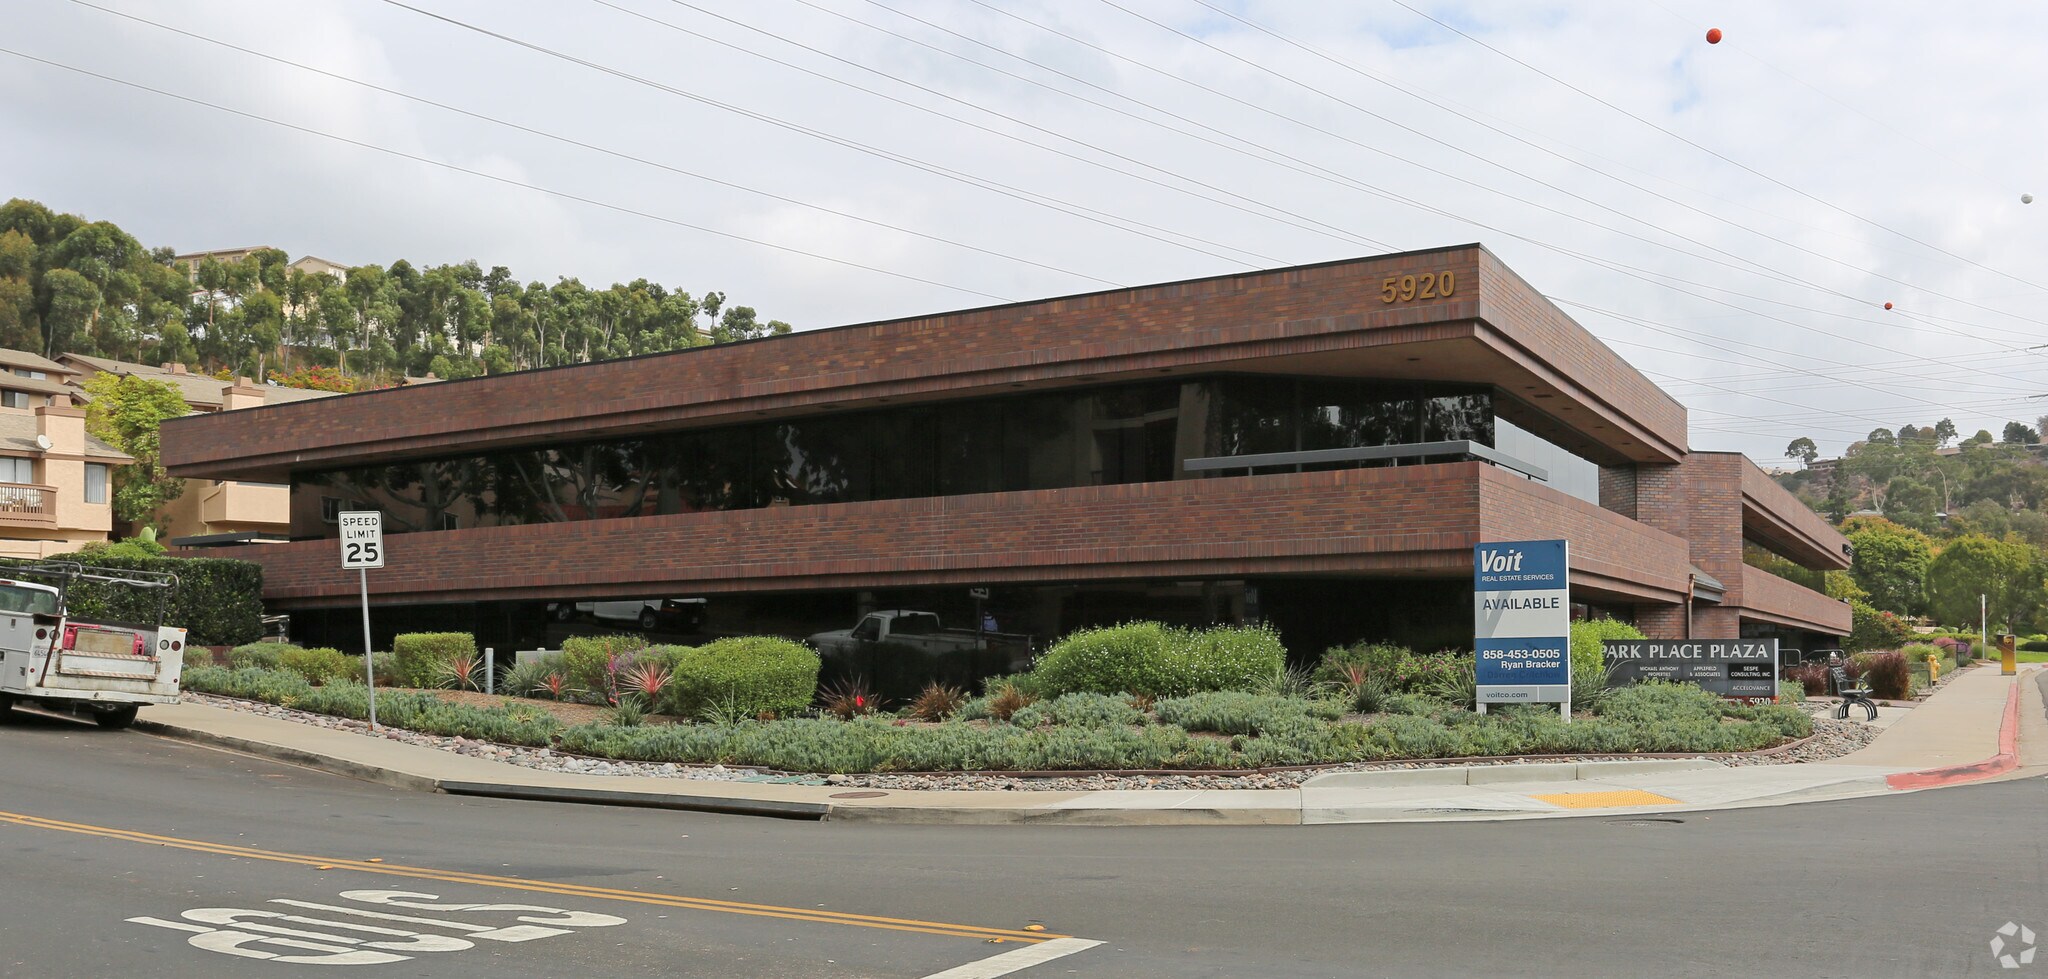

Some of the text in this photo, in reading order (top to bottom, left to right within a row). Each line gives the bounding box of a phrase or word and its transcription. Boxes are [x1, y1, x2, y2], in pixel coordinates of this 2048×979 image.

[1381, 270, 1456, 304] 5920
[342, 517, 379, 526] SPEED
[346, 529, 376, 539] LIMIT
[346, 542, 379, 563] 25
[1481, 549, 1524, 573] Voit
[1499, 574, 1522, 582] ESTATE
[1522, 573, 1554, 581] SERVICES
[1482, 597, 1560, 610] AVAILABLE
[1482, 649, 1561, 660] 858-453-0505
[1601, 644, 1769, 659] PARK PLACE PLAZA
[1500, 659, 1561, 671] Ryan Bracker
[1486, 691, 1528, 699] voitco.com
[124, 889, 628, 965] STOP
